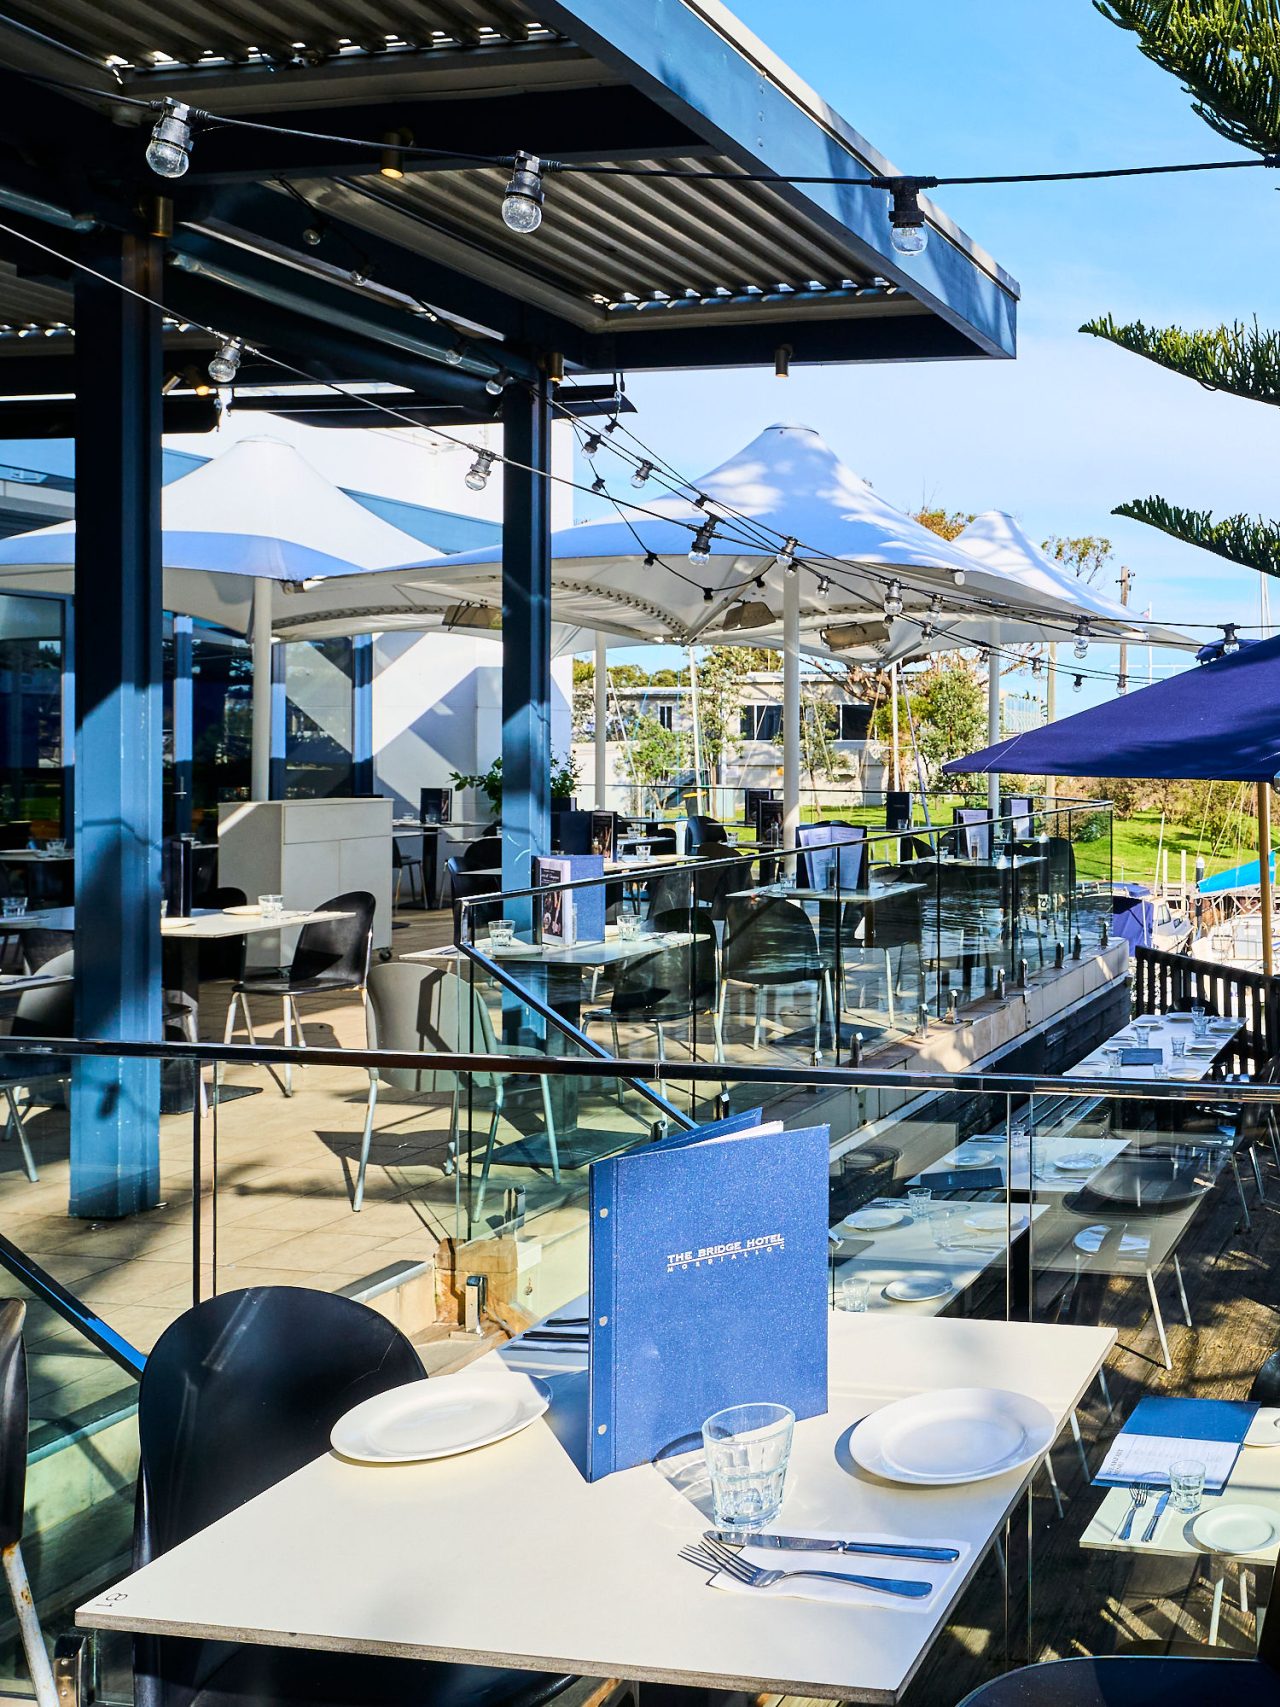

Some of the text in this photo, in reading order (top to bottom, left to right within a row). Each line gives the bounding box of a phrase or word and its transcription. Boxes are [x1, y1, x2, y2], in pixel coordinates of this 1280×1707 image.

[667, 1233, 785, 1263] THE BRIDGE HOTEL
